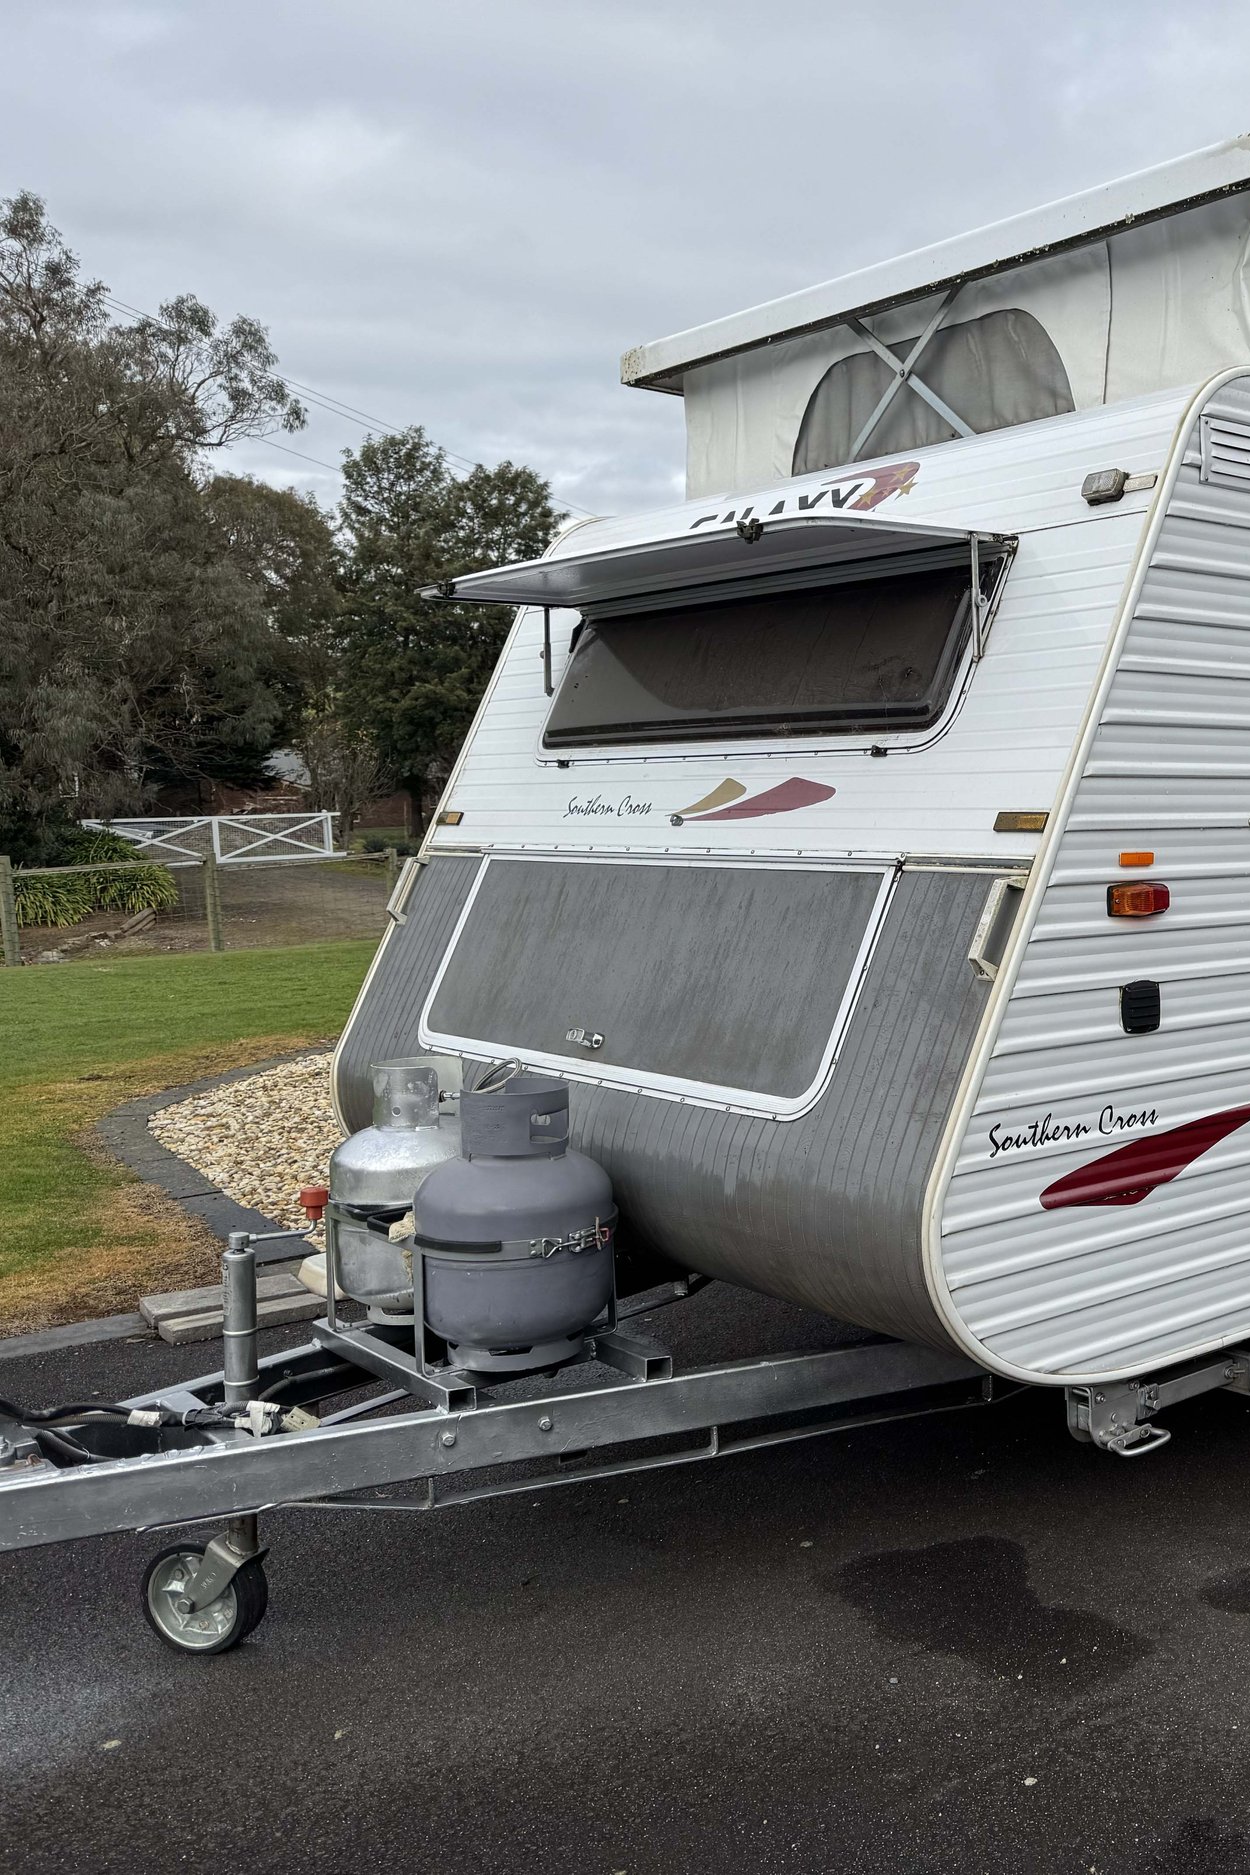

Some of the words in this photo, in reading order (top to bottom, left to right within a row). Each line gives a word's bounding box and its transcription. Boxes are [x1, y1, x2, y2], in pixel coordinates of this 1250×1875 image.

[563, 794, 615, 818] Southern
[617, 795, 652, 817] Cross
[988, 1112, 1091, 1158] Southern
[1098, 1104, 1159, 1136] Cross
